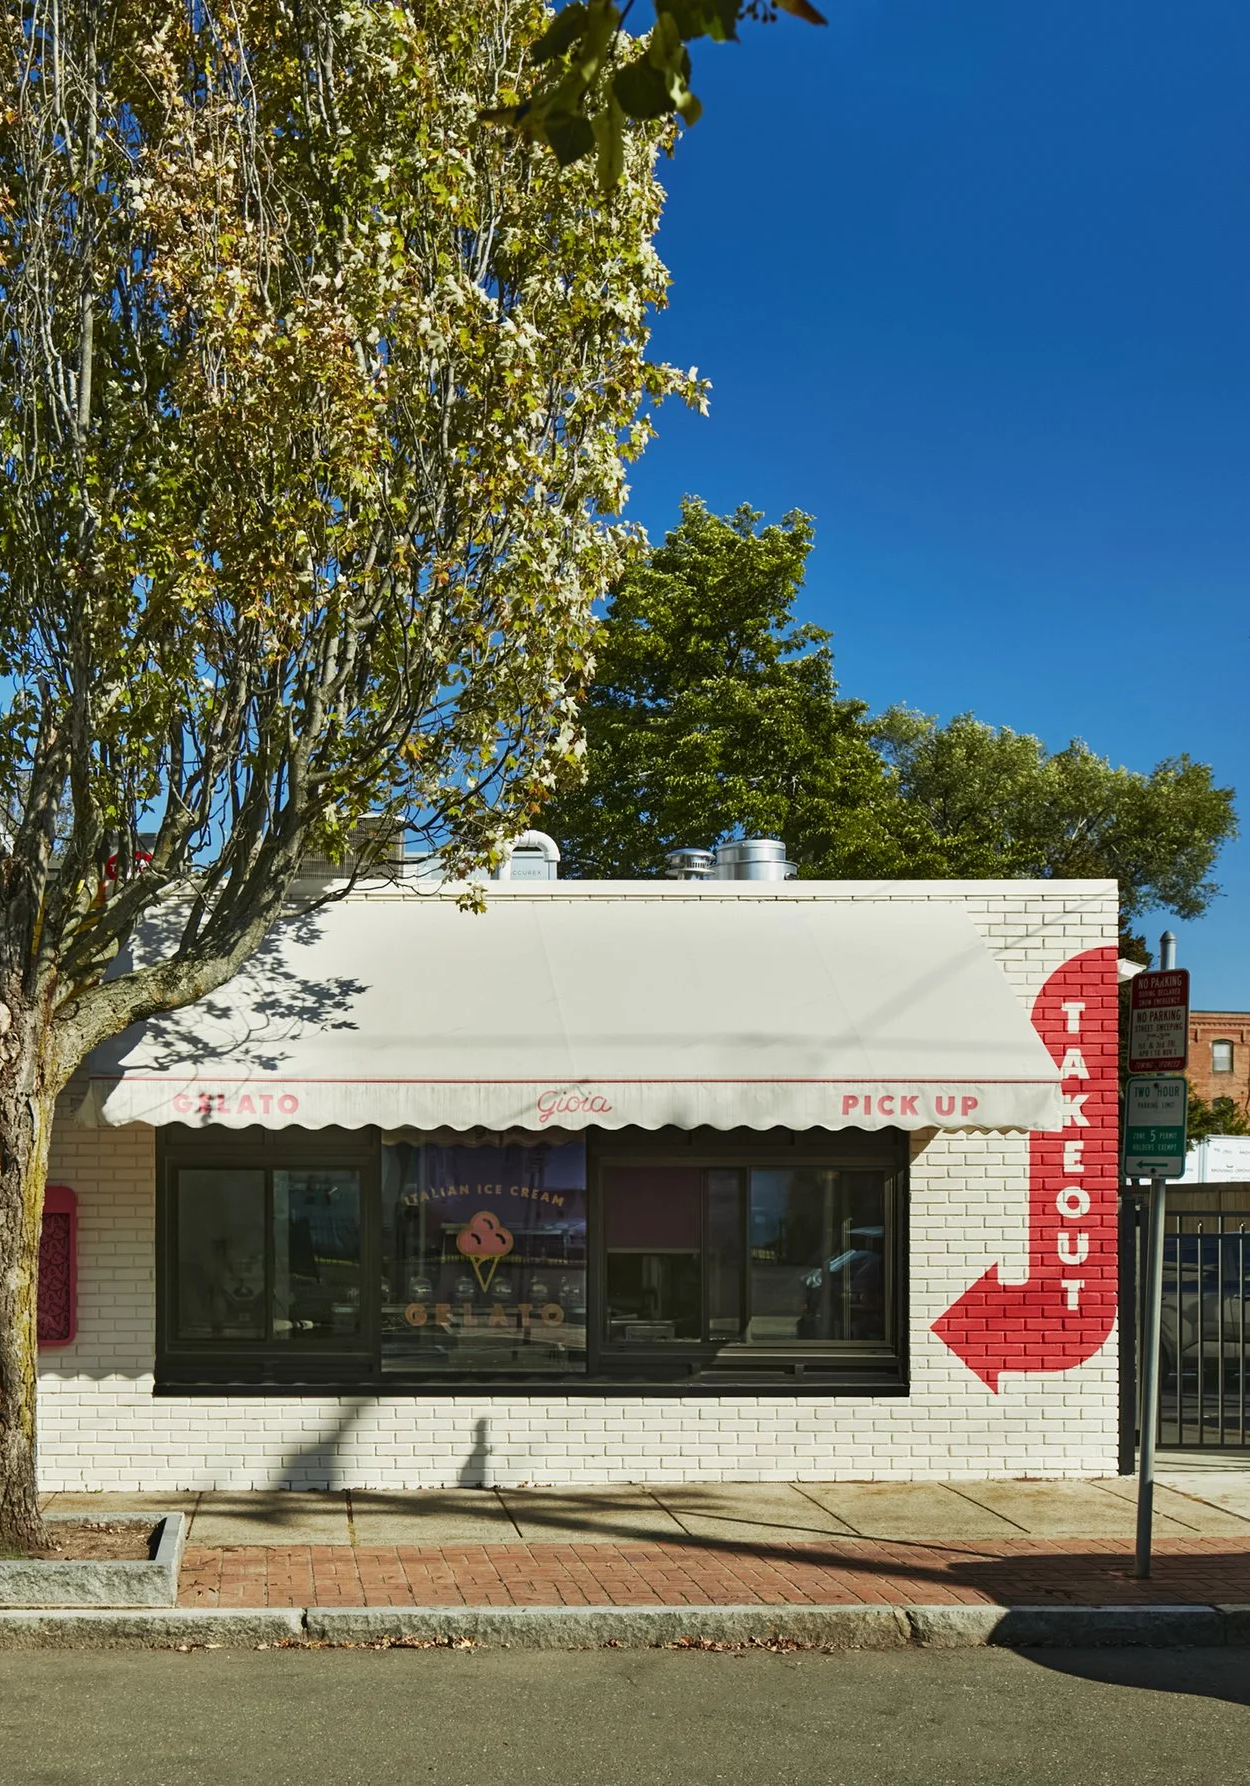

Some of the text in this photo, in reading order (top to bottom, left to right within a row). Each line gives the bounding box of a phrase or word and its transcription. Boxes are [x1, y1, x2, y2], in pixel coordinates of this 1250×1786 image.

[1138, 975, 1182, 989] NO PARKING
[1136, 1009, 1181, 1023] NO PARKING
[1135, 1022, 1183, 1033] STREET SWEEPING
[1133, 1085, 1180, 1098] TWO HOUR
[173, 1093, 299, 1115] GELATO
[537, 1090, 612, 1123] Gioia
[842, 1095, 978, 1116] PICK UP
[1150, 1129, 1156, 1143] 5
[1055, 1002, 1091, 1311] TAKEOUT
[404, 1184, 565, 1207] ITALIAN ICE CREAM
[405, 1303, 564, 1327] GELATO
